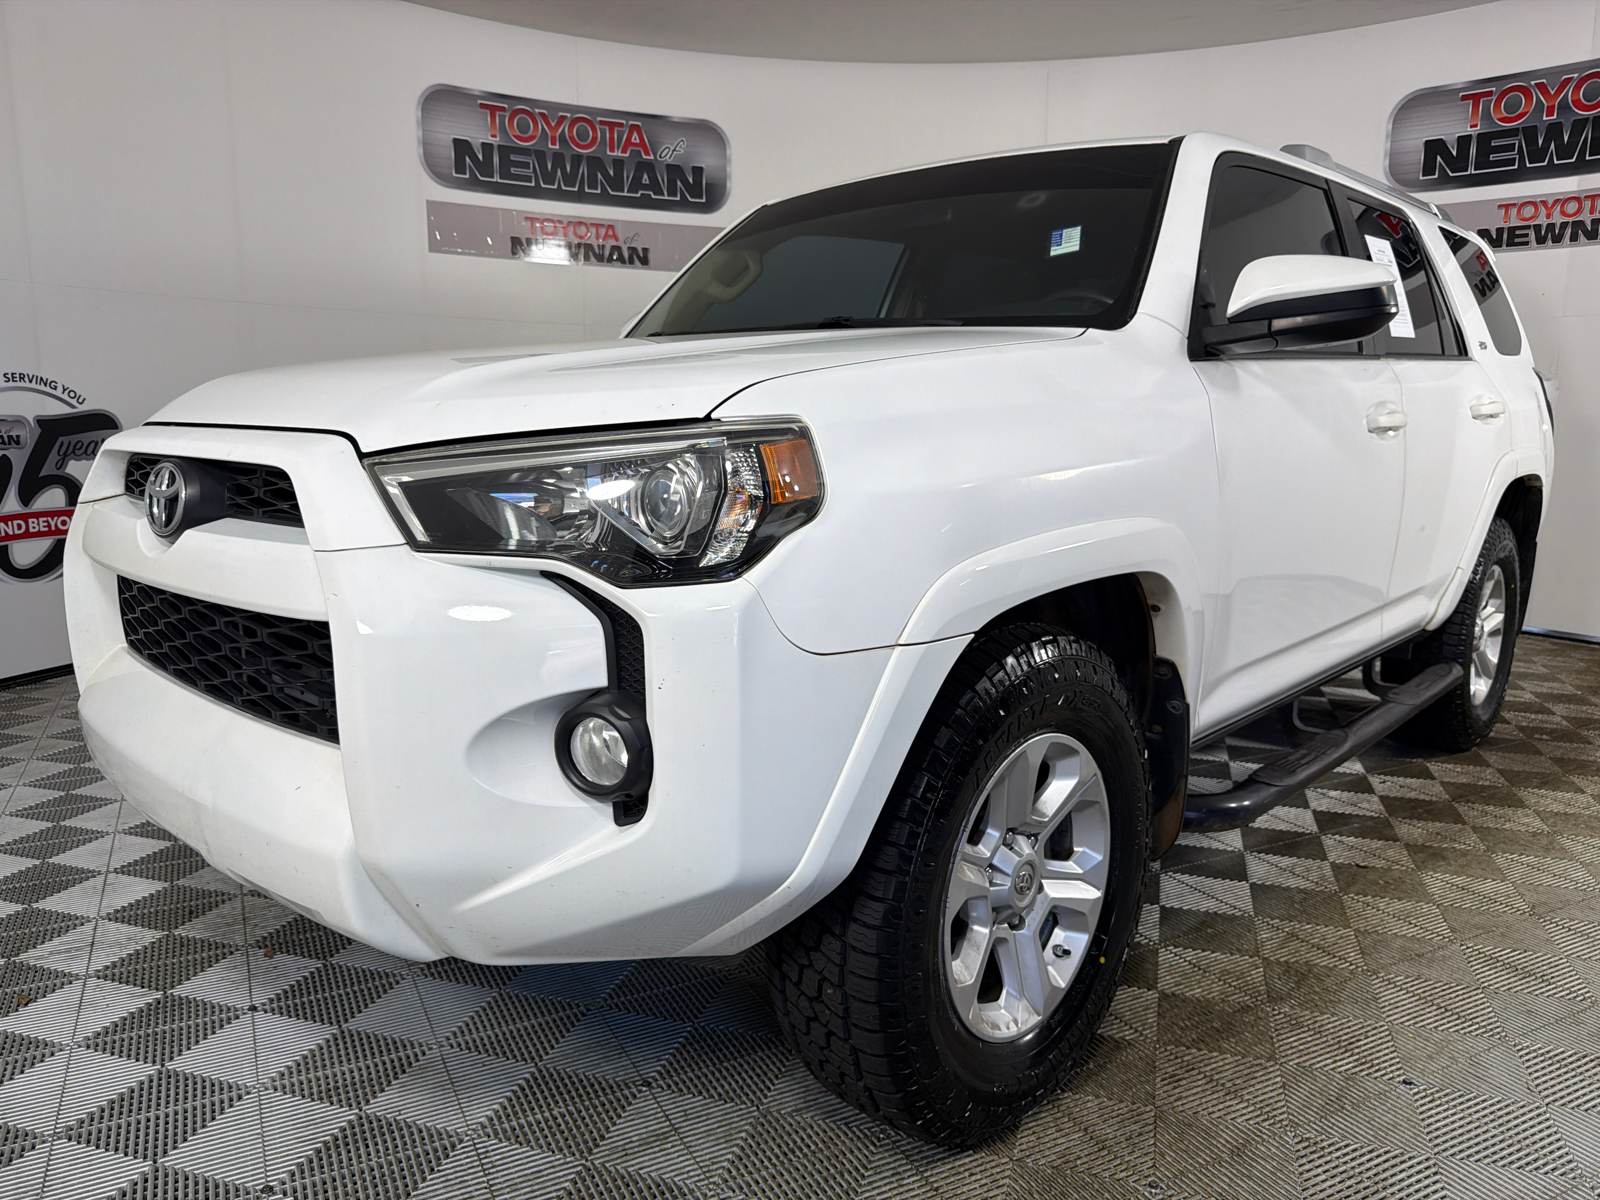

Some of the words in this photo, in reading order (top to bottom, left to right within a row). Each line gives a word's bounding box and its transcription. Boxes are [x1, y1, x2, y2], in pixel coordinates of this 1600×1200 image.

[478, 100, 653, 159] TOYOTA
[657, 138, 686, 161] of
[452, 137, 706, 202] NEWNAN
[1497, 193, 1600, 224] TOYOT
[524, 216, 619, 243] TOYOTA
[623, 232, 639, 244] of
[1477, 218, 1600, 249] NEWN
[3, 372, 59, 391] SERVING
[61, 383, 87, 405] YOU
[55, 438, 105, 471] yea
[0, 519, 26, 537] ND
[28, 516, 74, 533] BEYO
